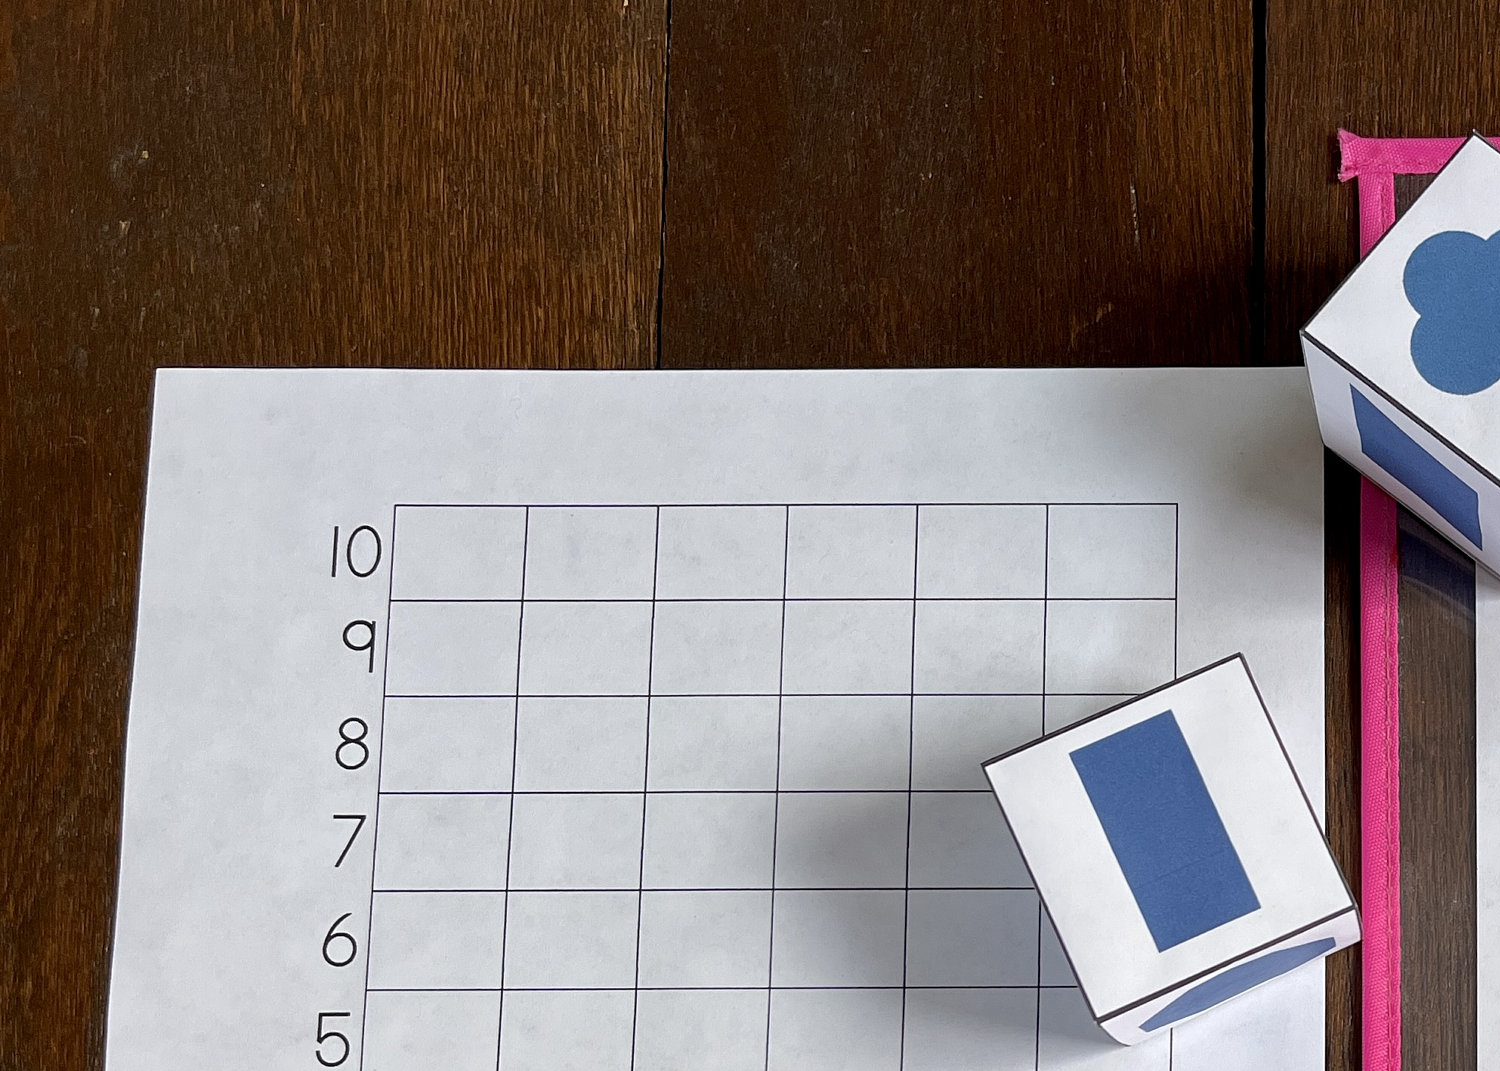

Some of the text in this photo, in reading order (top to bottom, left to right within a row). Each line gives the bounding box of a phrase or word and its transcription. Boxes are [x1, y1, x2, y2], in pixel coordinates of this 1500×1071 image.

[331, 525, 382, 578] 10
[342, 619, 377, 673] 9
[335, 717, 369, 770] 8
[333, 814, 367, 868] 7
[322, 912, 357, 967] 6
[315, 1012, 351, 1068] 5
